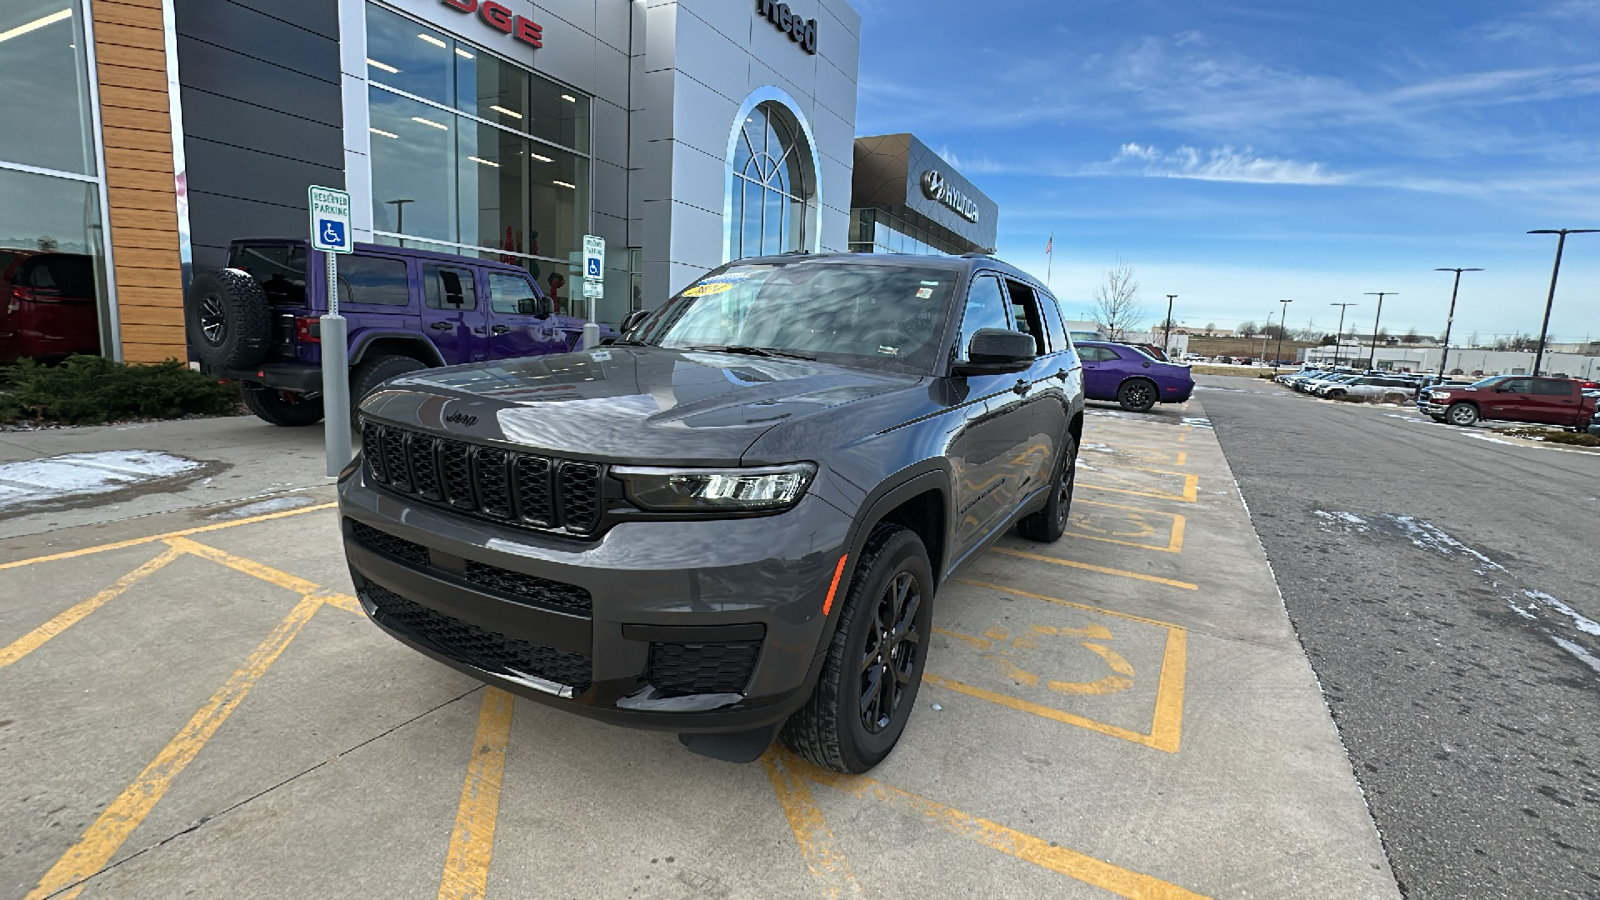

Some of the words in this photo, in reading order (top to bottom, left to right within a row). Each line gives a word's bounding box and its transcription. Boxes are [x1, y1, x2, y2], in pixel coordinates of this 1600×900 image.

[313, 192, 347, 205] RESERVED
[945, 183, 979, 222] HYUNDAI
[314, 203, 347, 216] PARKING
[446, 410, 479, 428] Jeep
